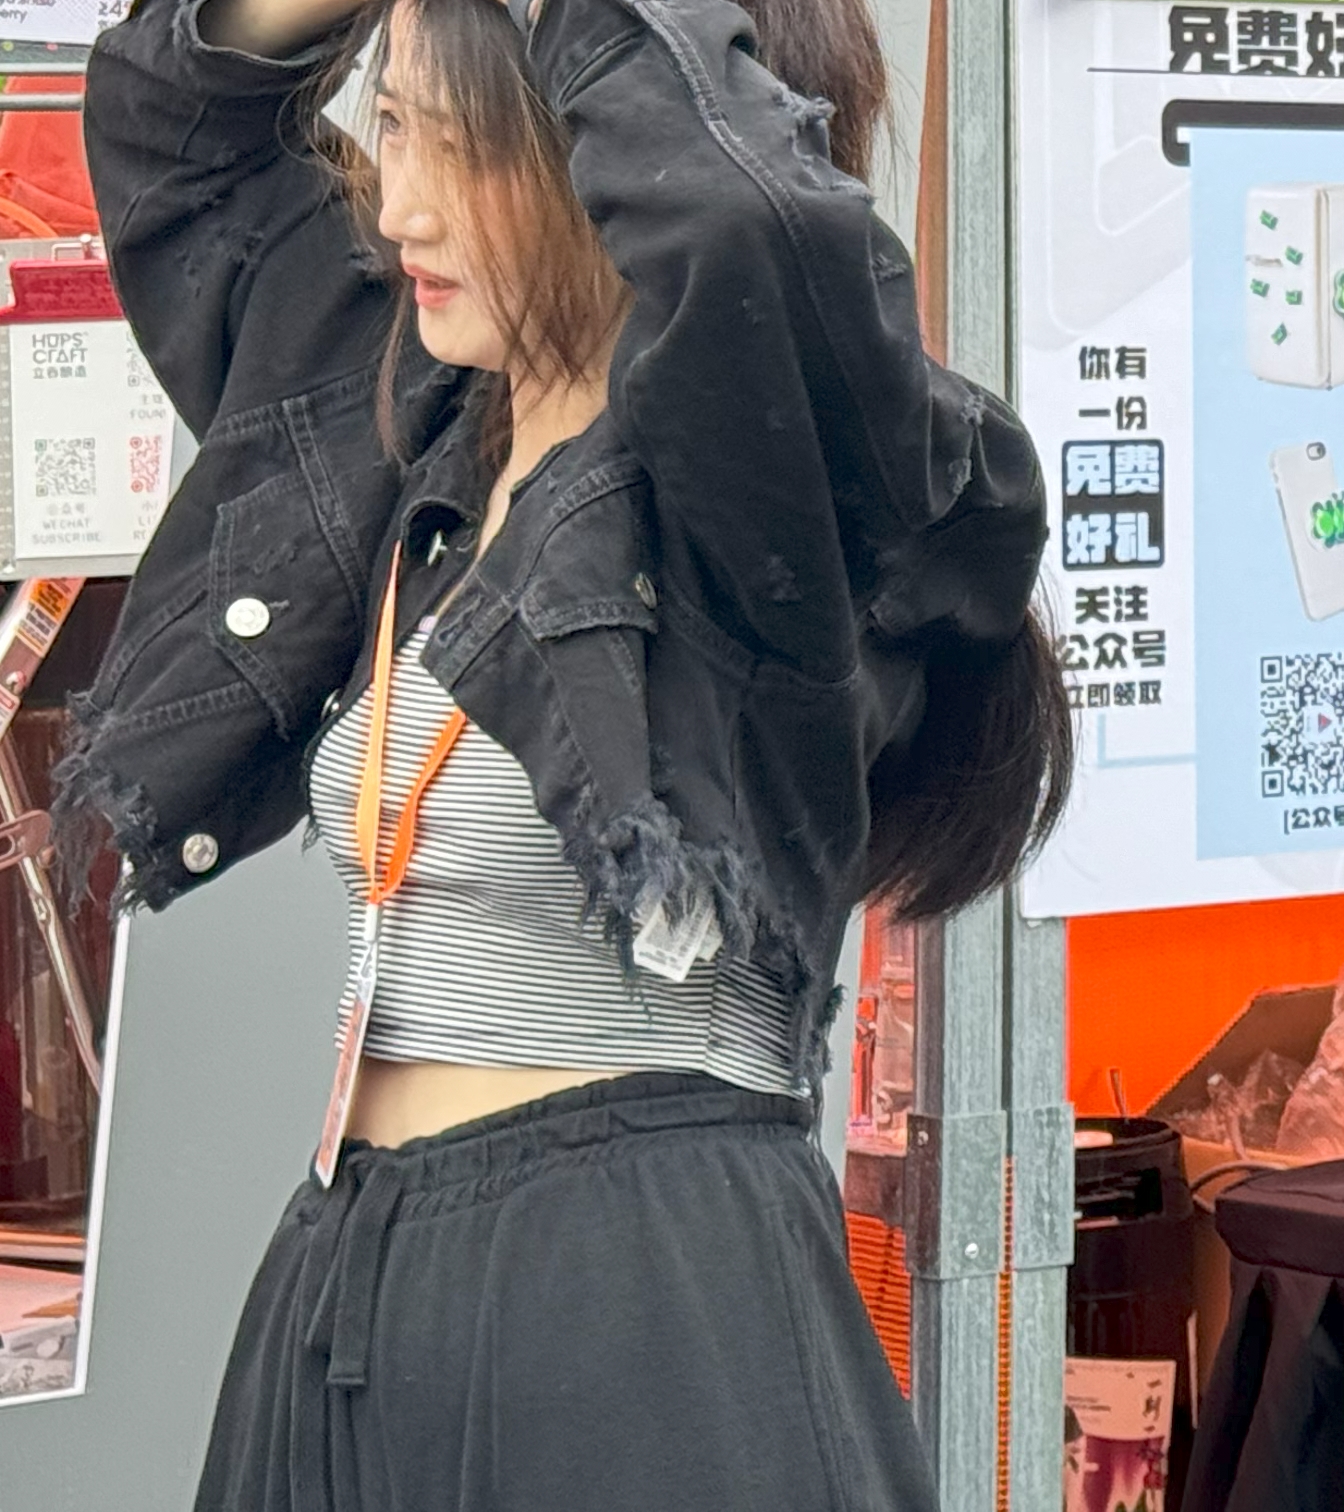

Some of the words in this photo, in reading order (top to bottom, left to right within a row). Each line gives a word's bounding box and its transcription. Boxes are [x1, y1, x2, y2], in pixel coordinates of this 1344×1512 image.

[32, 333, 83, 349] HOPS
[1079, 346, 1147, 380] 你有
[1078, 396, 1147, 431] 一份
[1066, 446, 1160, 495] 免费
[1066, 512, 1160, 564] 好礼
[1075, 586, 1149, 623] 关注
[1062, 629, 1166, 670] 公众号
